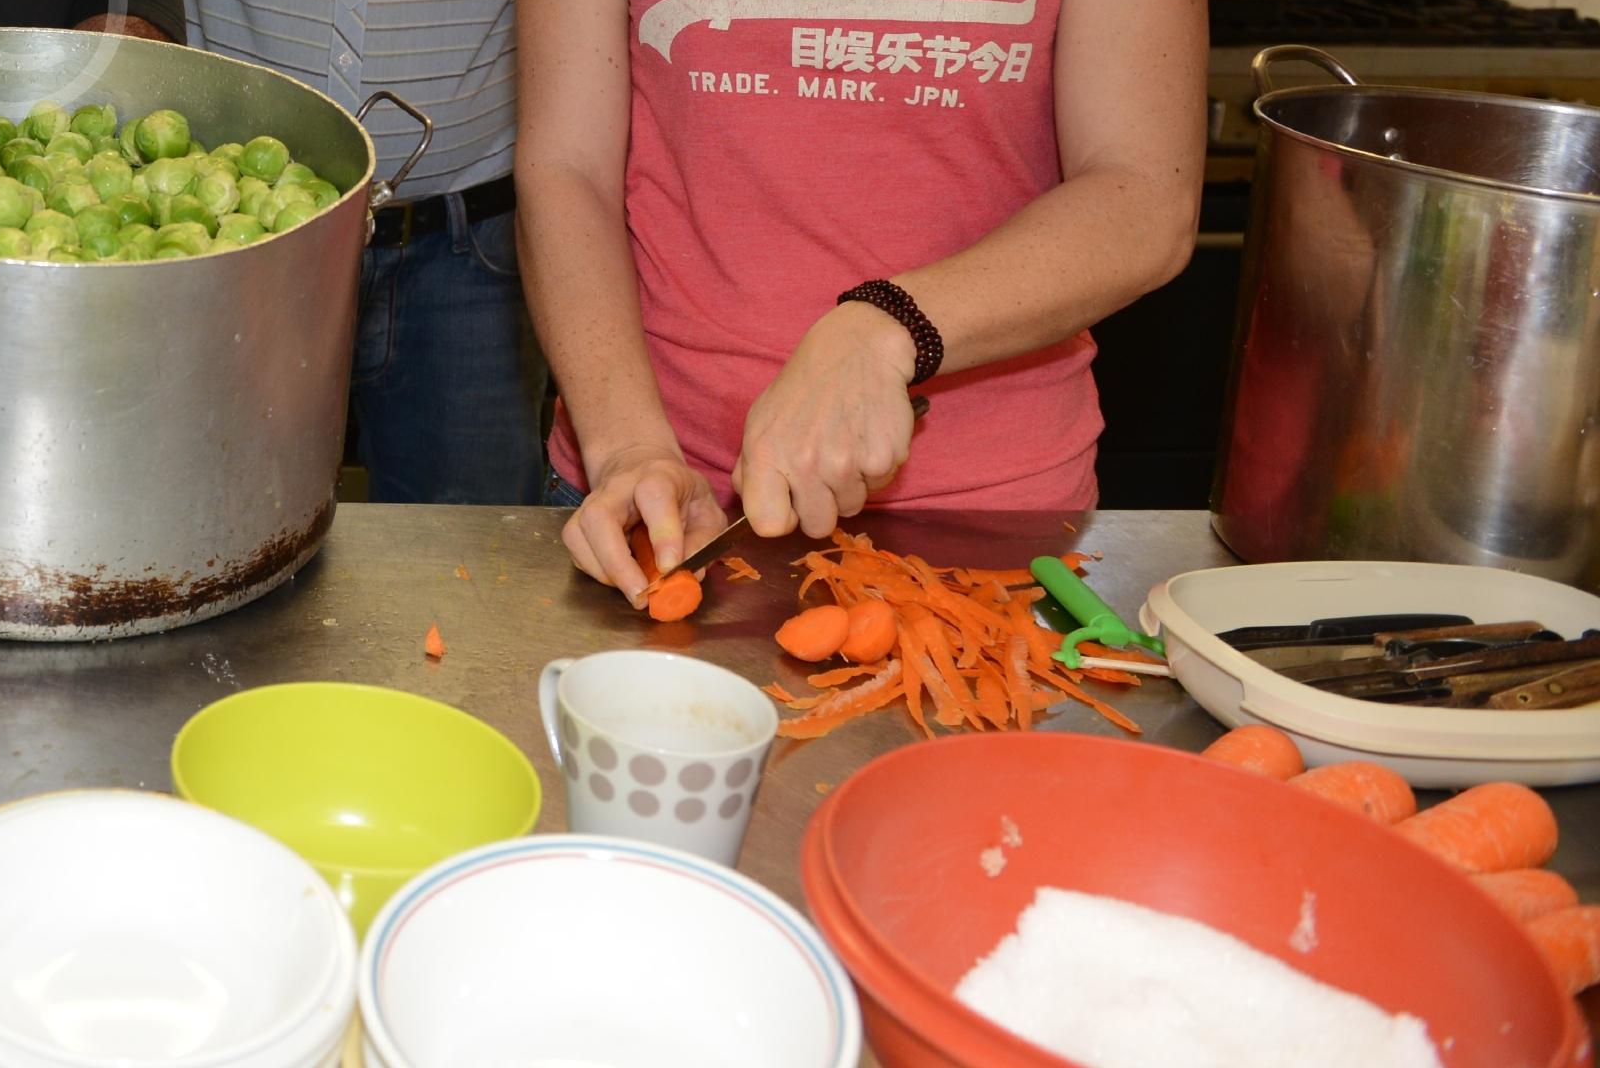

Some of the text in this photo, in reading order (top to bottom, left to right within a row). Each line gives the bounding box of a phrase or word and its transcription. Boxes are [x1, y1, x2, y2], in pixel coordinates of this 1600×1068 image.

[689, 71, 966, 109] TRADE. MARK. JPN.
